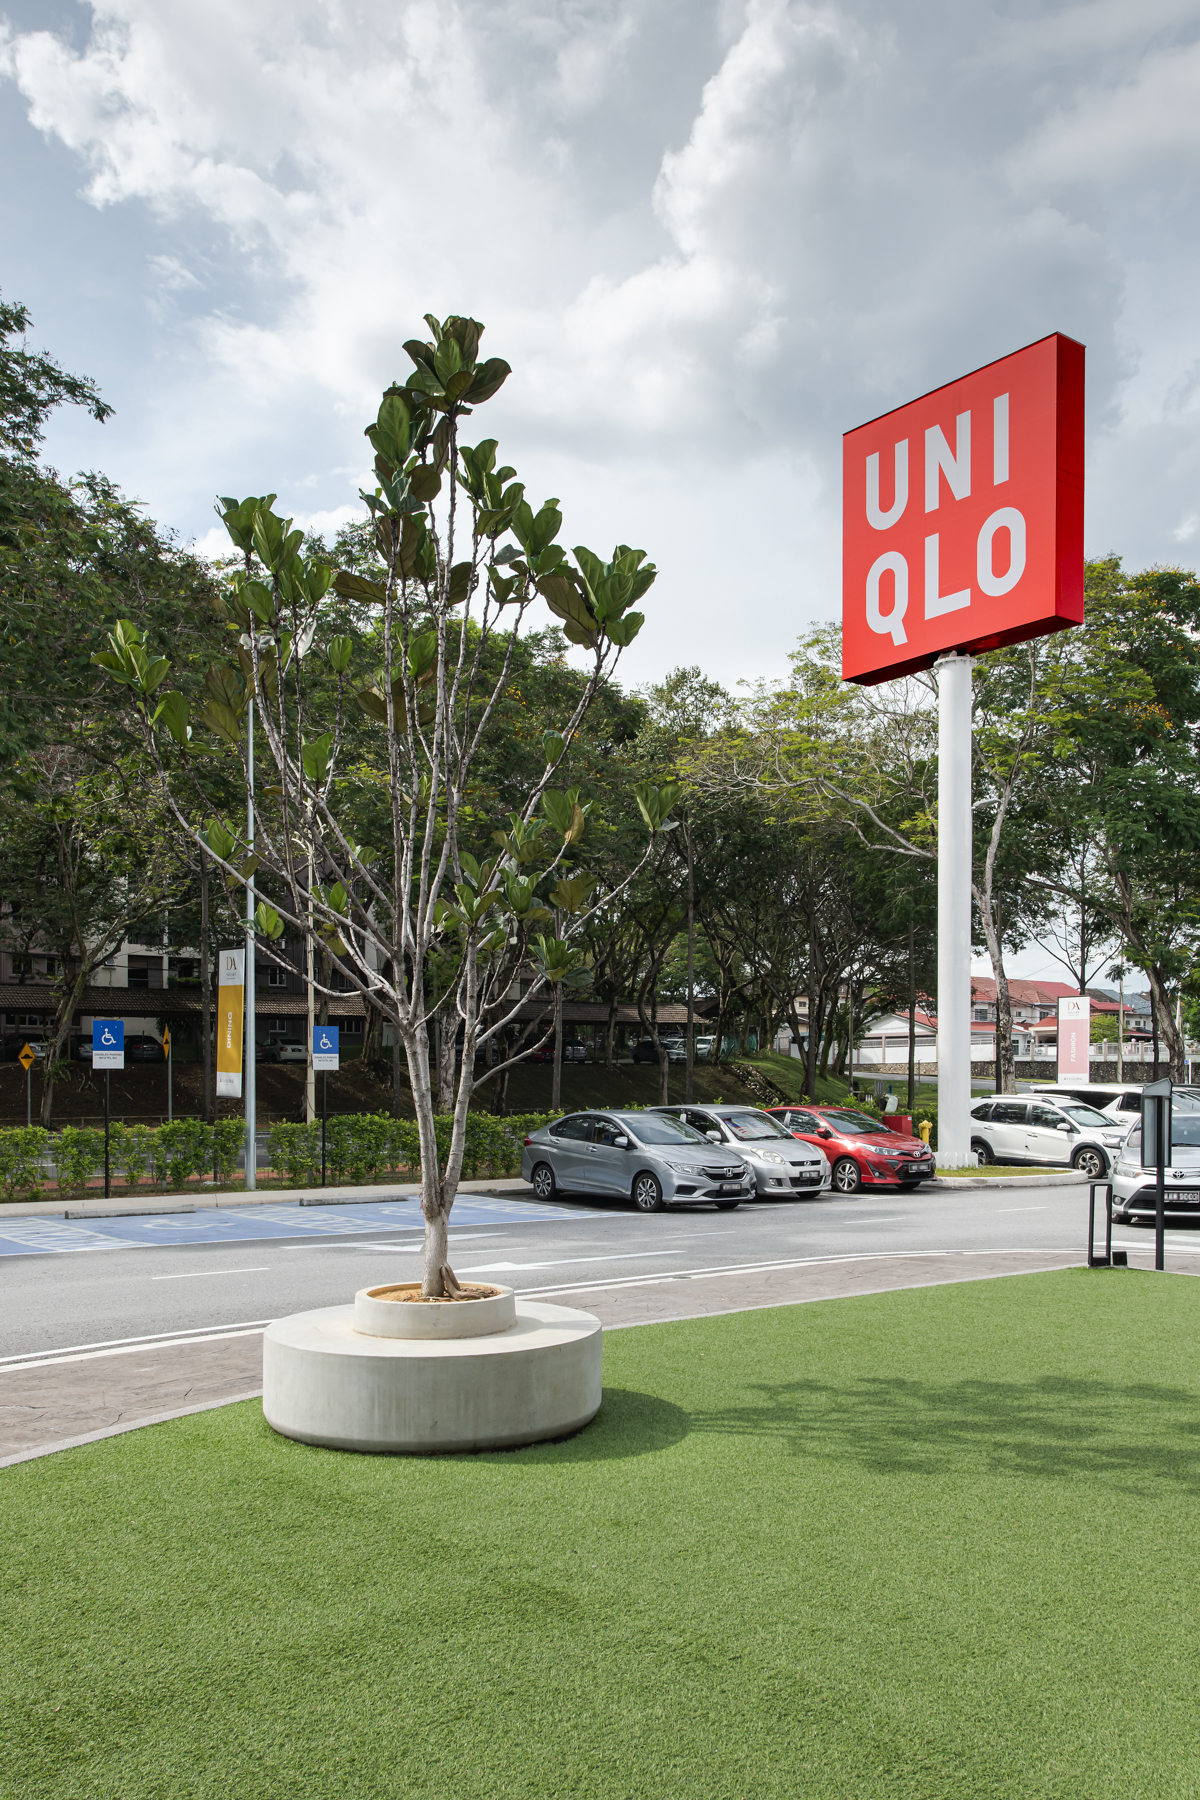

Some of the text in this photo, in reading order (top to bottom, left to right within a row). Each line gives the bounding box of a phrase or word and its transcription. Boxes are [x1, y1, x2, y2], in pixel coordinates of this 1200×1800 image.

[866, 392, 1009, 531] UNI
[866, 506, 1026, 647] QLO
[226, 956, 237, 970] DA
[1067, 1001, 1081, 1011] DA
